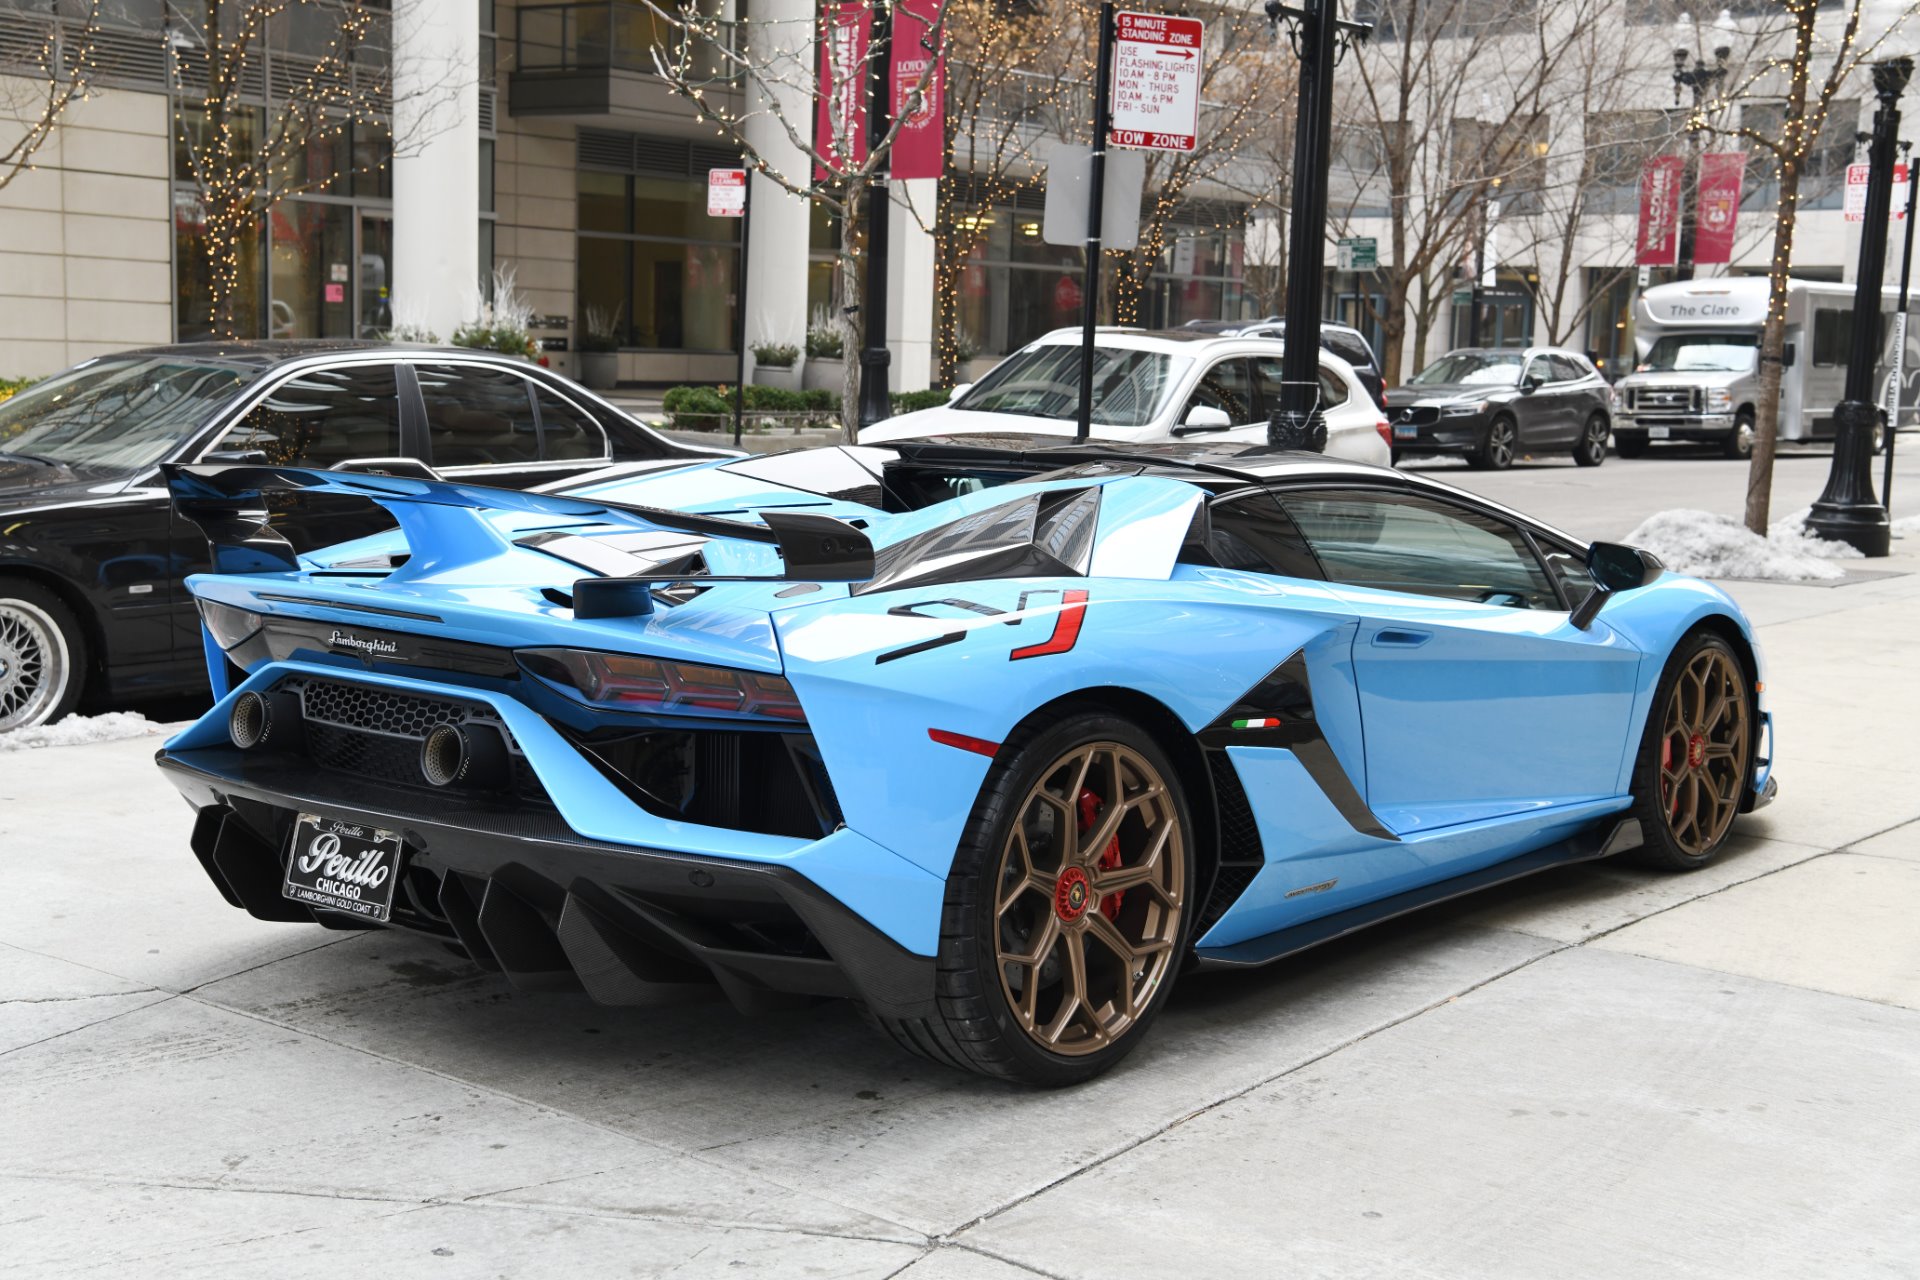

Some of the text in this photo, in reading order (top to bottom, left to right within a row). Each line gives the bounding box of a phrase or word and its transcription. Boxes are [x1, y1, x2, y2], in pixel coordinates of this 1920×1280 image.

[1122, 16, 1167, 31] 15 MINUTE
[1122, 28, 1193, 45] STANDING ZONE
[1120, 46, 1138, 57] USE
[1120, 57, 1195, 74] FLASHING LIGHTS
[1120, 68, 1128, 78] 10
[1131, 69, 1144, 78] AM
[1153, 71, 1159, 81] 8
[1162, 72, 1176, 82] PM
[1118, 79, 1139, 90] MON
[1149, 82, 1179, 94] THURS
[1118, 90, 1127, 100] 10
[1128, 91, 1142, 101] AM
[1152, 94, 1158, 103] 6
[1160, 95, 1173, 104] PM
[1117, 101, 1132, 111] FRI
[1141, 103, 1160, 114] SUN
[1115, 130, 1188, 149] TOW ZONE
[1670, 304, 1740, 316] The Clare
[1888, 314, 1903, 424] CONSIGNMENT VEHICLE
[328, 630, 398, 655] Lamborghini
[329, 821, 364, 837] Perillo
[298, 832, 389, 889] Perillo
[316, 877, 361, 900] CHICAGO
[297, 889, 372, 914] LAMBORGHINI GOLD COAST
